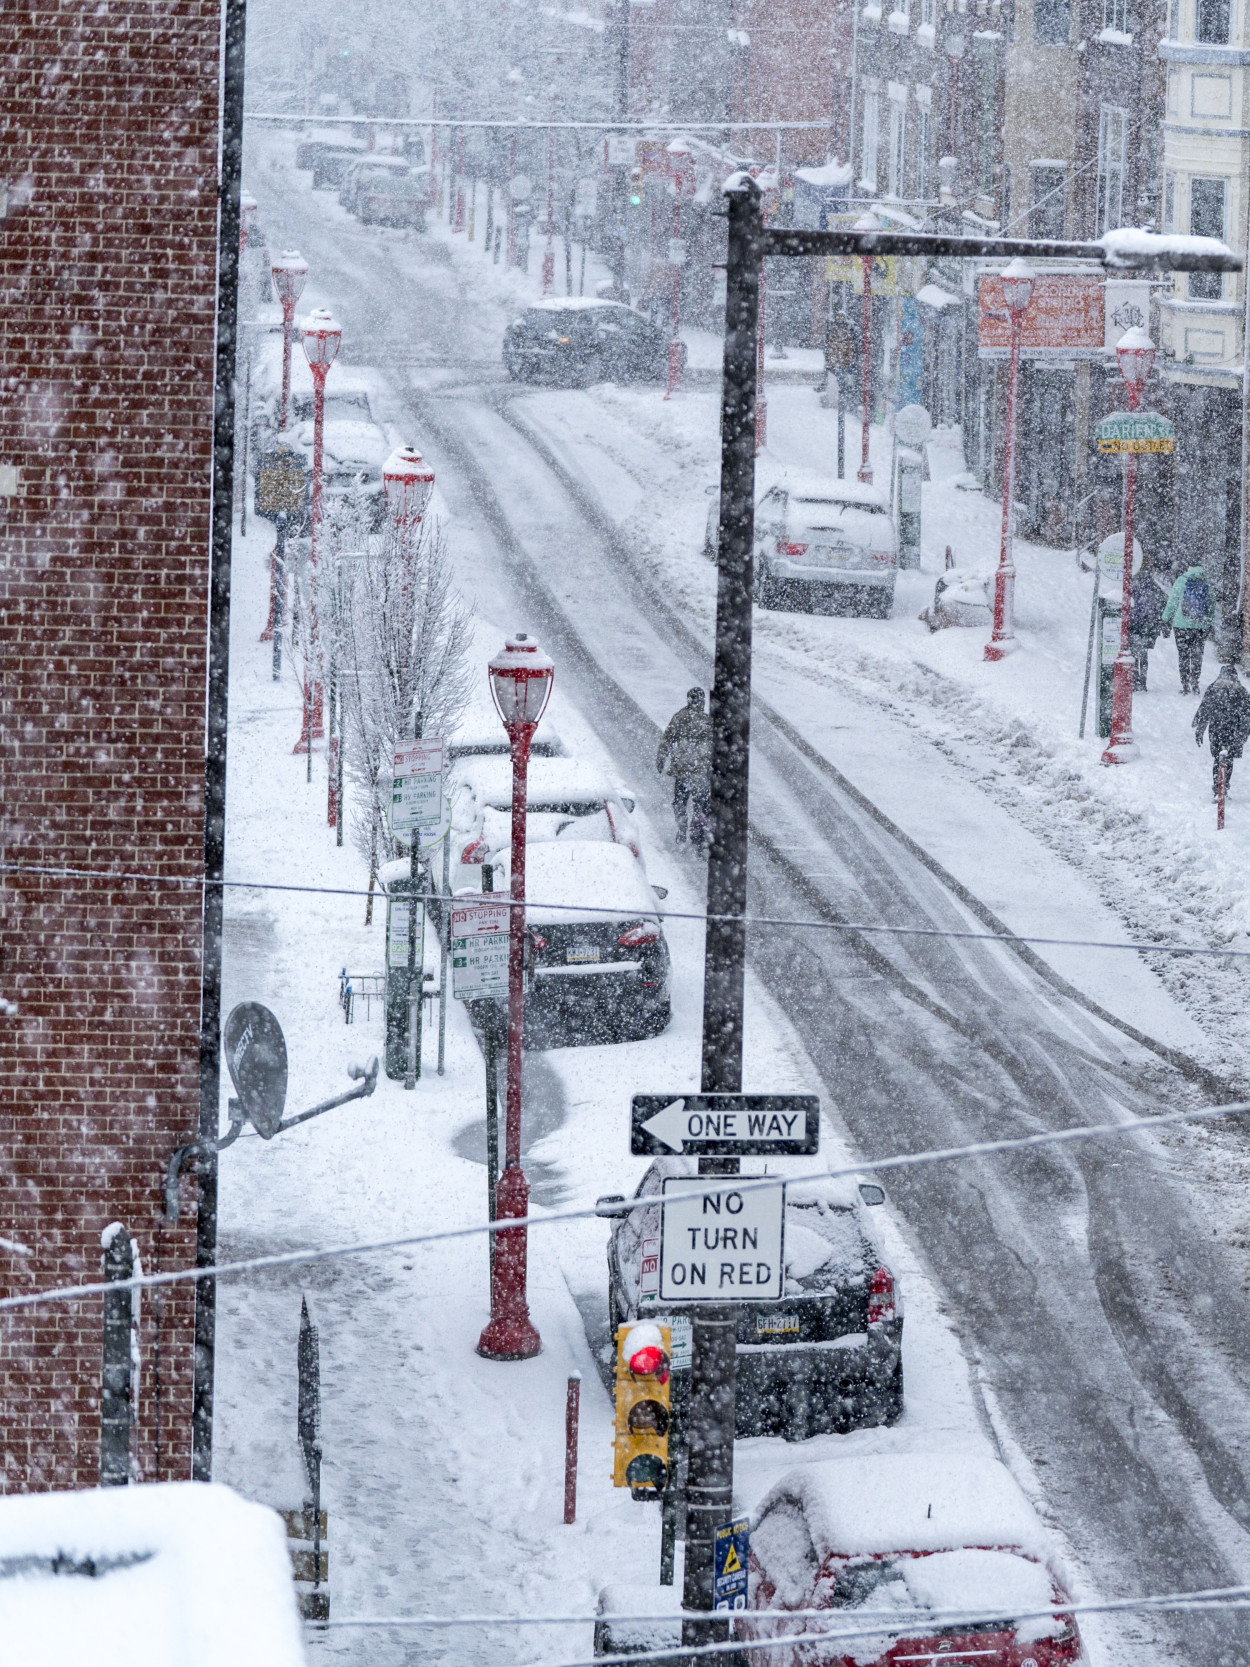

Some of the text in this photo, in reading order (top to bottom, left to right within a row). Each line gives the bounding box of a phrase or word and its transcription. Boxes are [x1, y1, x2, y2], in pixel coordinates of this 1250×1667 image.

[1102, 424, 1156, 439] DARIEN
[469, 909, 507, 921] STOPPING
[688, 1114, 799, 1137] ONE WAY
[703, 1191, 744, 1214] NO
[687, 1228, 758, 1250] TURN
[643, 1261, 656, 1273] NO
[671, 1263, 771, 1285] ON RED
